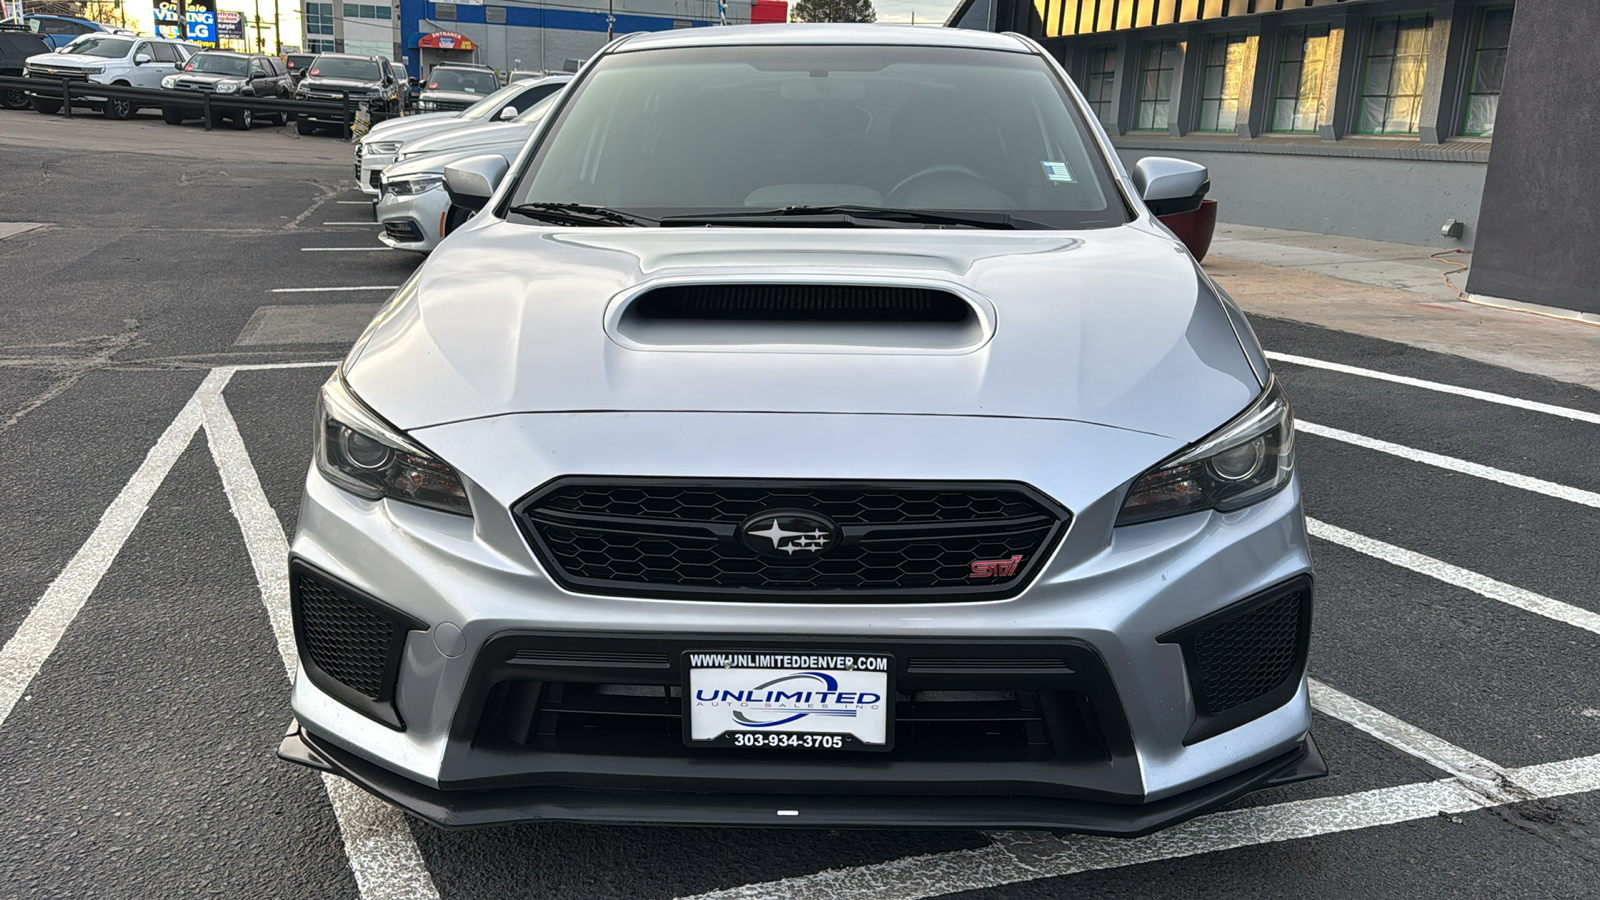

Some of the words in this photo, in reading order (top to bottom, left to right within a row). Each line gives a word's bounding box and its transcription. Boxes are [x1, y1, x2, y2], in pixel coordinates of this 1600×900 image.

[159, 1, 178, 11] On
[432, 31, 462, 39] ENTRANCE
[690, 654, 888, 670] WWWUNLIMITEDDENVER.COM
[696, 689, 881, 704] UNLIMITED
[734, 734, 843, 748] 303-934-3705
